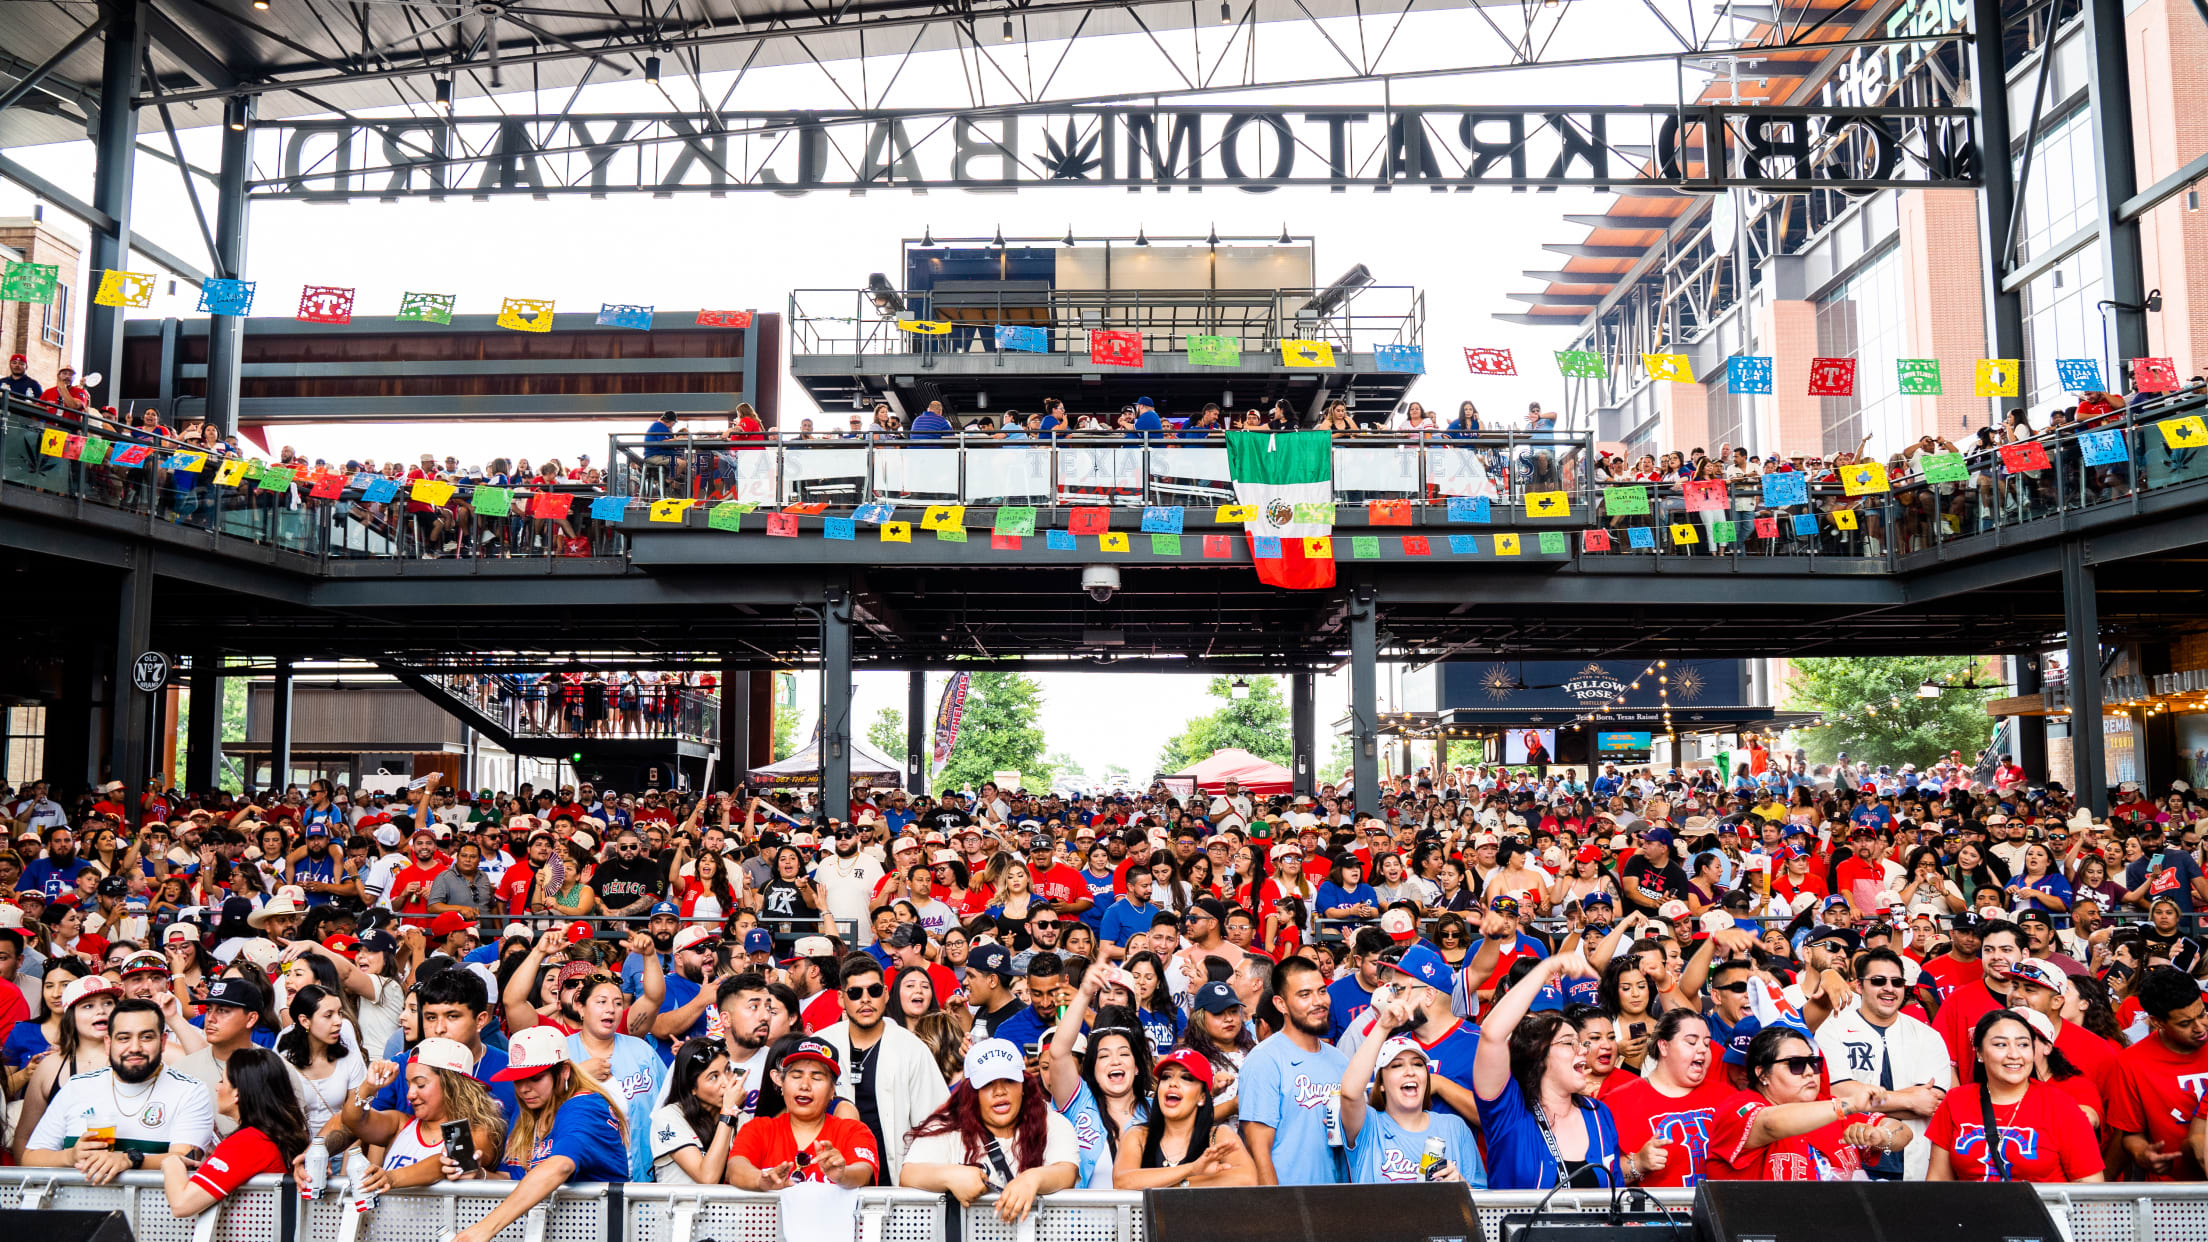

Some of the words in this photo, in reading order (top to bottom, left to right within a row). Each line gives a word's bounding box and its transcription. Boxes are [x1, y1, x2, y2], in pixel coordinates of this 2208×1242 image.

[1560, 680, 1628, 693] YELLOW
[1575, 689, 1613, 700] ROSE
[1616, 713, 1635, 721] Texas
[1543, 985, 1556, 999] T
[1734, 1035, 1752, 1046] TEX
[977, 1048, 1014, 1066] DALLAS
[1543, 1130, 1561, 1163] GUESS
